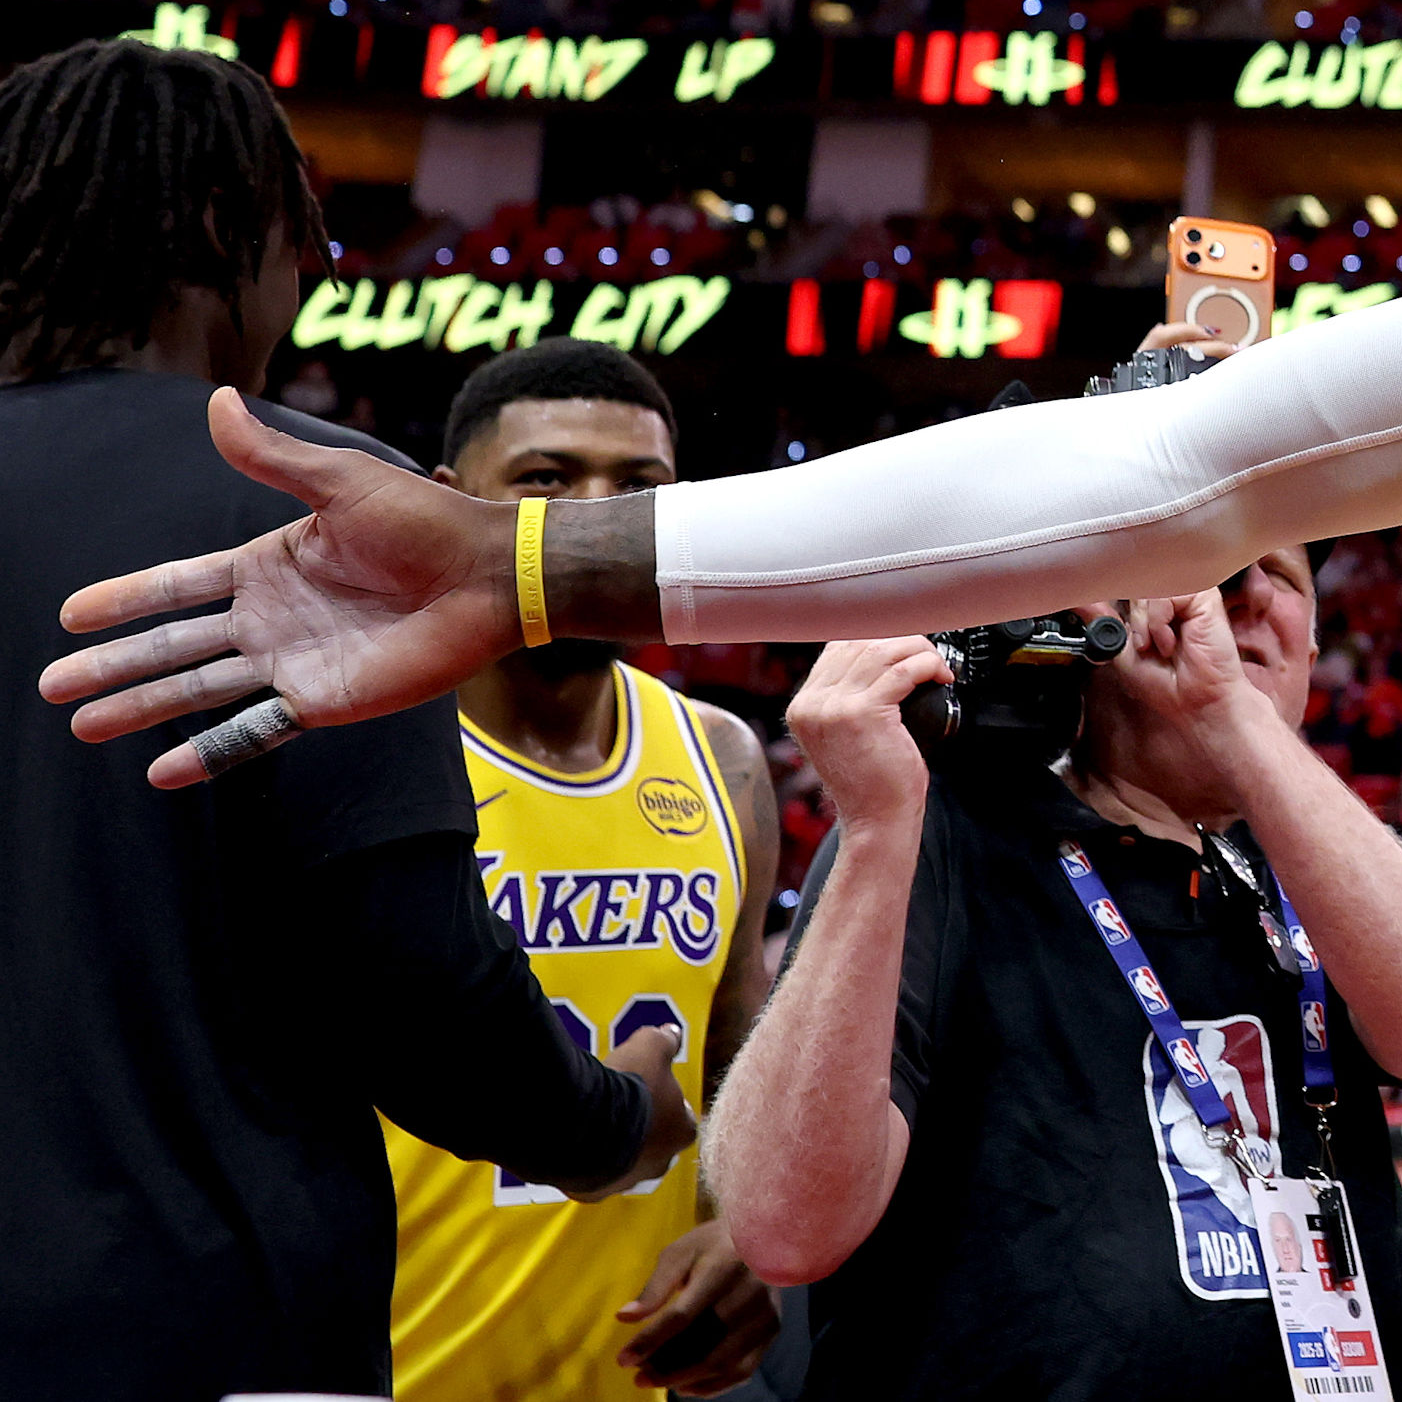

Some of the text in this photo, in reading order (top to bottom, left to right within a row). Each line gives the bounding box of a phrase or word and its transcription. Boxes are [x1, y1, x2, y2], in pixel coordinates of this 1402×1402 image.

[438, 34, 775, 103] STAND UP
[291, 273, 730, 354] CLUTCH CITY
[522, 514, 539, 580] AKRON
[642, 791, 702, 819] bibigo
[1197, 1231, 1261, 1278] NBA
